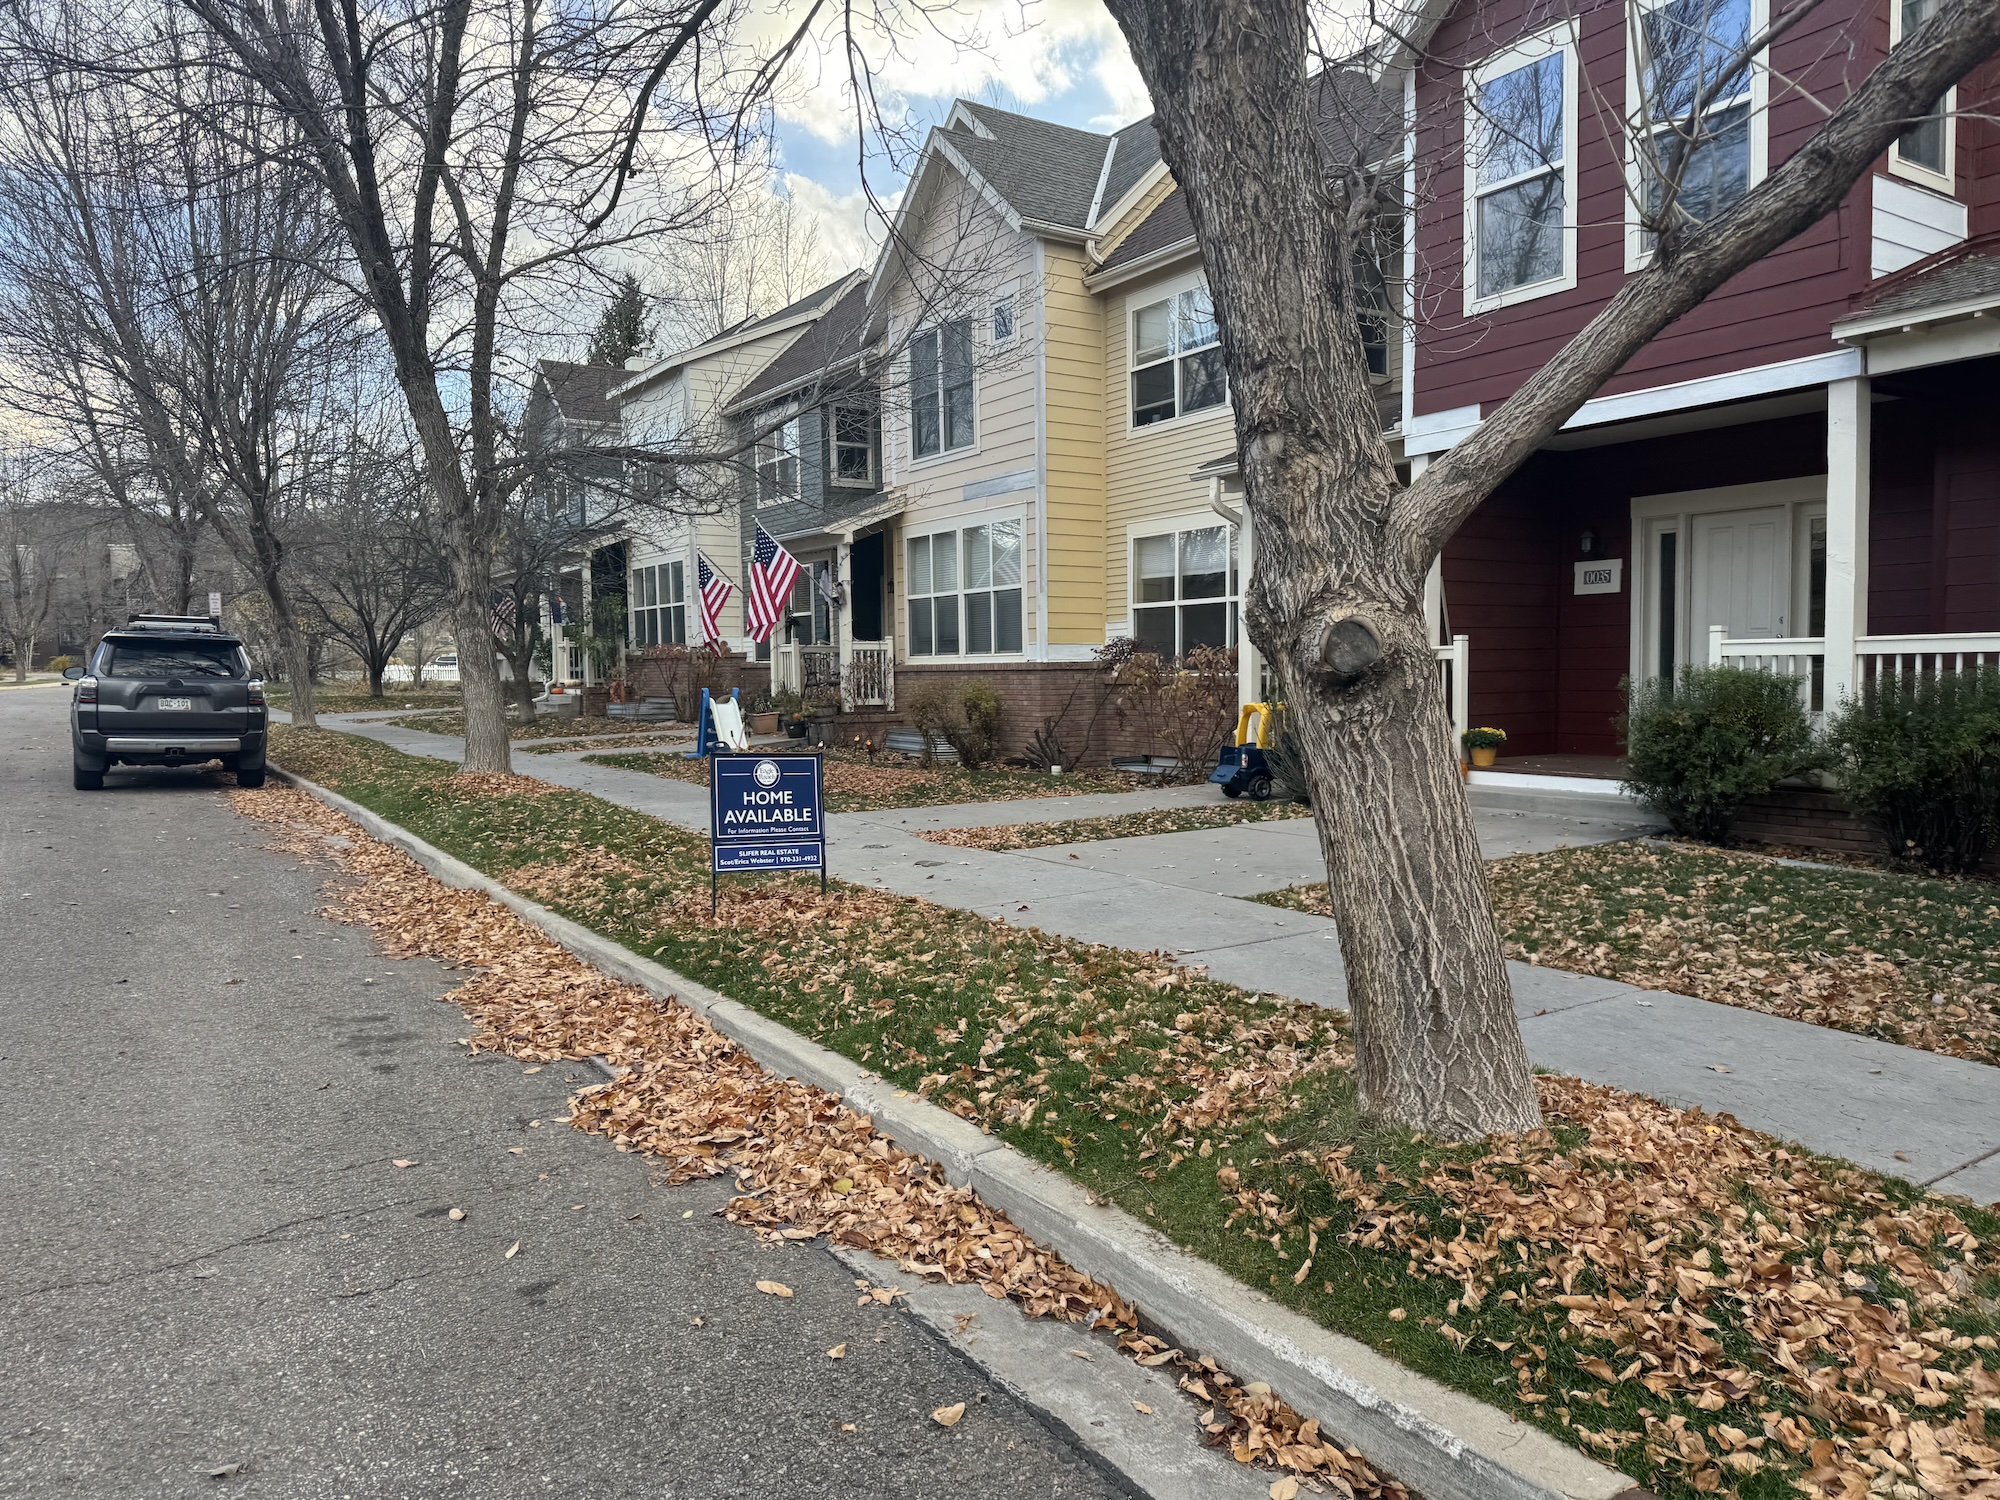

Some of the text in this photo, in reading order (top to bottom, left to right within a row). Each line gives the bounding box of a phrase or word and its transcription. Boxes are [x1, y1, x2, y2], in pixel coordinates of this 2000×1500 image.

[1586, 570, 1610, 584] 0035
[743, 790, 793, 805] HOME
[724, 808, 812, 824] AVAILABLE
[738, 826, 769, 834] Information
[738, 849, 759, 857] SLIFER
[780, 855, 817, 863] 970-331-4932
